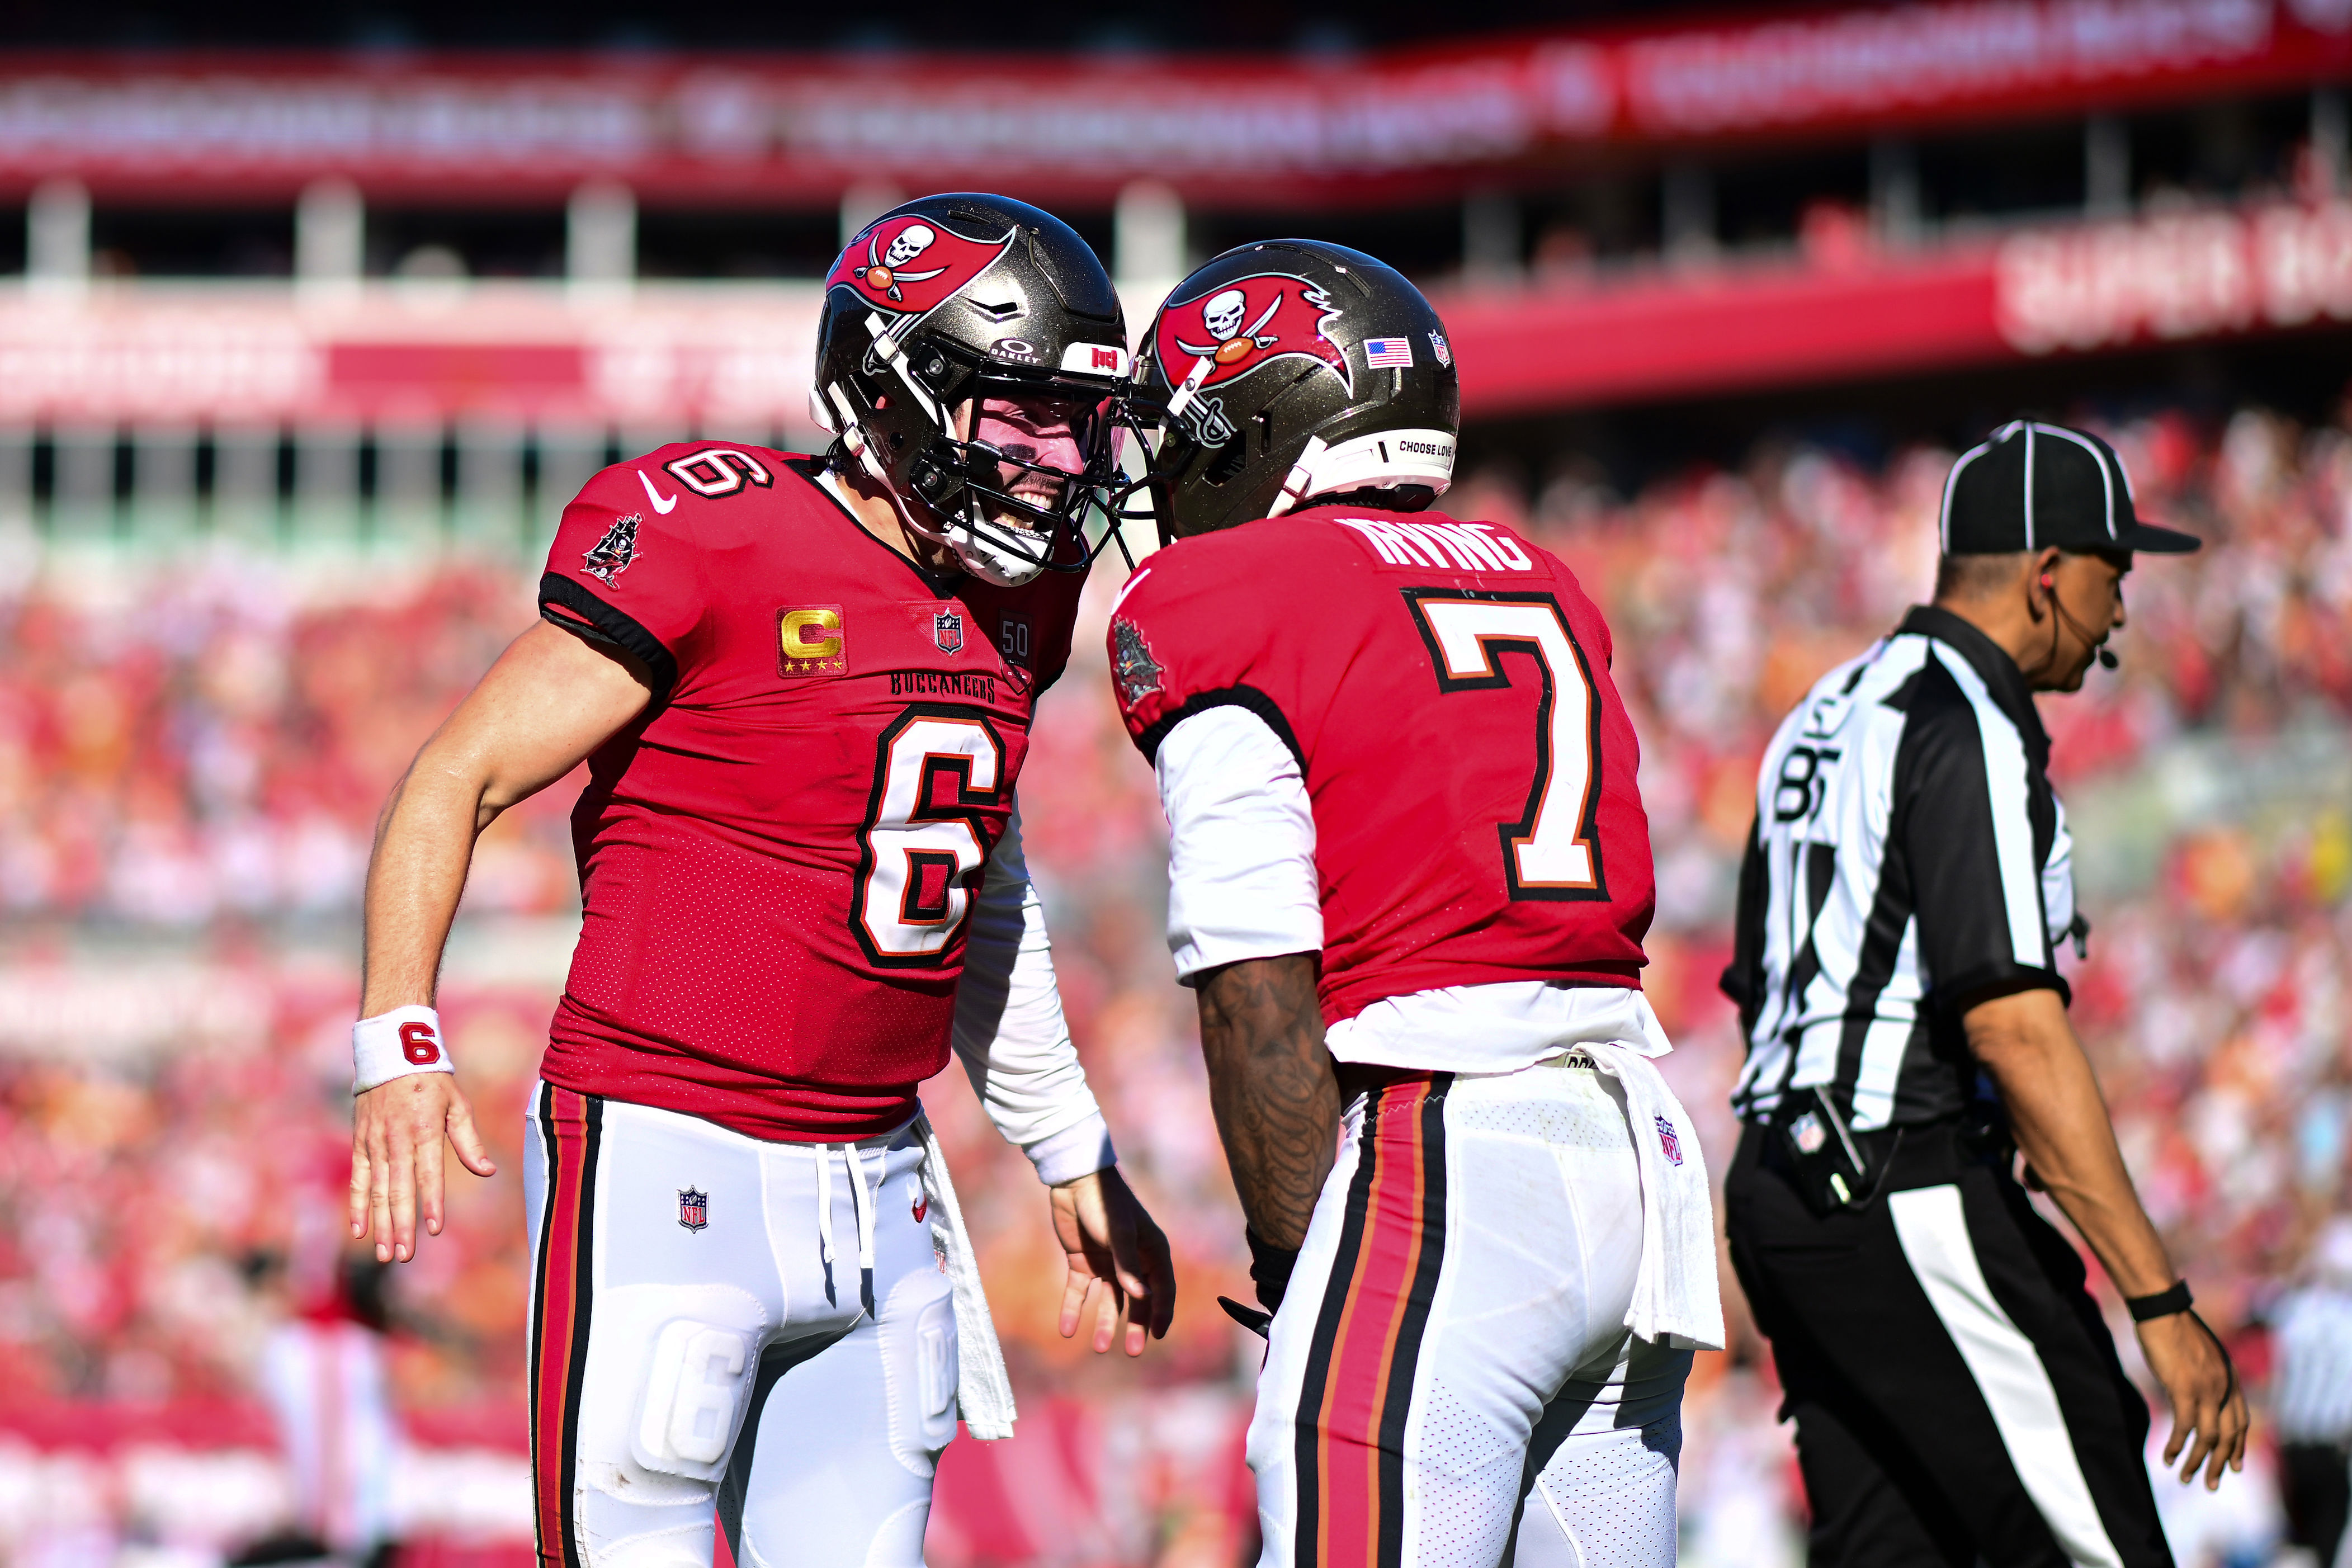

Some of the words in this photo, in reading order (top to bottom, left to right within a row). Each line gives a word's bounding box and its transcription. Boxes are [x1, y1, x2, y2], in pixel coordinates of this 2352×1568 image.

[991, 348, 1039, 364] OAKLEY
[1435, 346, 1449, 361] NFL
[1400, 441, 1436, 455] CHOOSE
[1437, 445, 1452, 457] LOVE
[662, 447, 775, 500] 6
[1333, 518, 1532, 572] IRVING
[781, 609, 842, 659] C
[938, 629, 961, 648] NFL
[1002, 620, 1028, 657] 50
[890, 672, 995, 705] BUCCANEERS
[1399, 586, 1613, 903] 7
[848, 703, 1007, 969] 6
[398, 1022, 441, 1066] 6
[1659, 1133, 1681, 1161] NFL
[682, 1205, 706, 1225] NFL
[670, 1328, 746, 1464] 6
